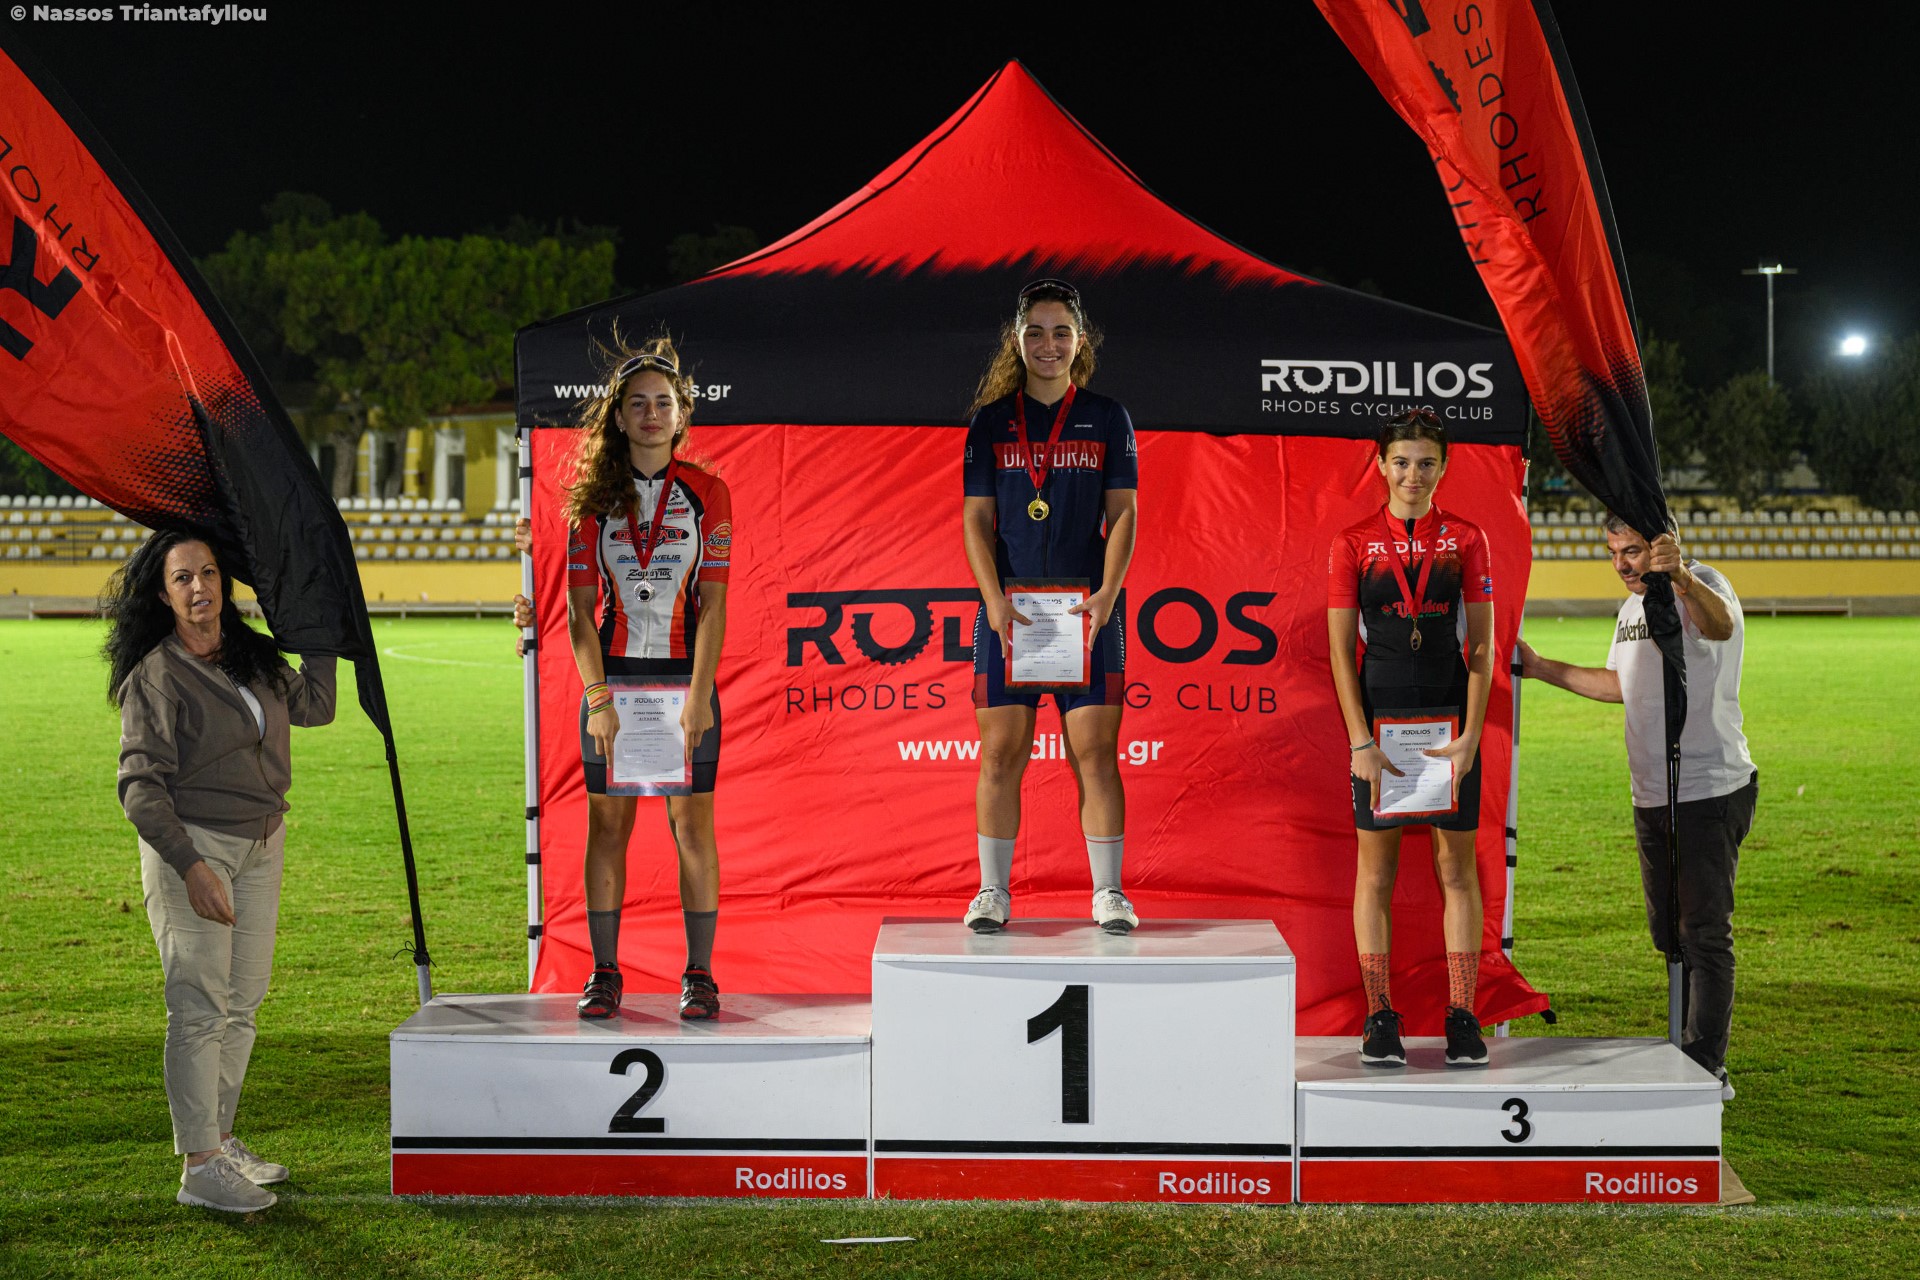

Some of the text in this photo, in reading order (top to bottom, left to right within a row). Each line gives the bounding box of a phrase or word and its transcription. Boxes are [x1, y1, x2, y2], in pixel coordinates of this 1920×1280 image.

[1454, 3, 1547, 223] RHODES
[1261, 359, 1494, 399] RODILIOS
[1262, 399, 1340, 414] RHODES
[1445, 406, 1493, 420] CLUB
[1367, 538, 1457, 554] RDILOS
[787, 587, 1278, 667] ROOS
[787, 683, 946, 714] RHODES
[1177, 683, 1277, 713] CLUB
[1027, 985, 1089, 1123] 1
[608, 1048, 664, 1133] 2
[1500, 1098, 1531, 1143] 3
[735, 1168, 847, 1190] Rodilios
[1159, 1172, 1271, 1195] Rodilios
[1586, 1172, 1698, 1195] Rodilios
